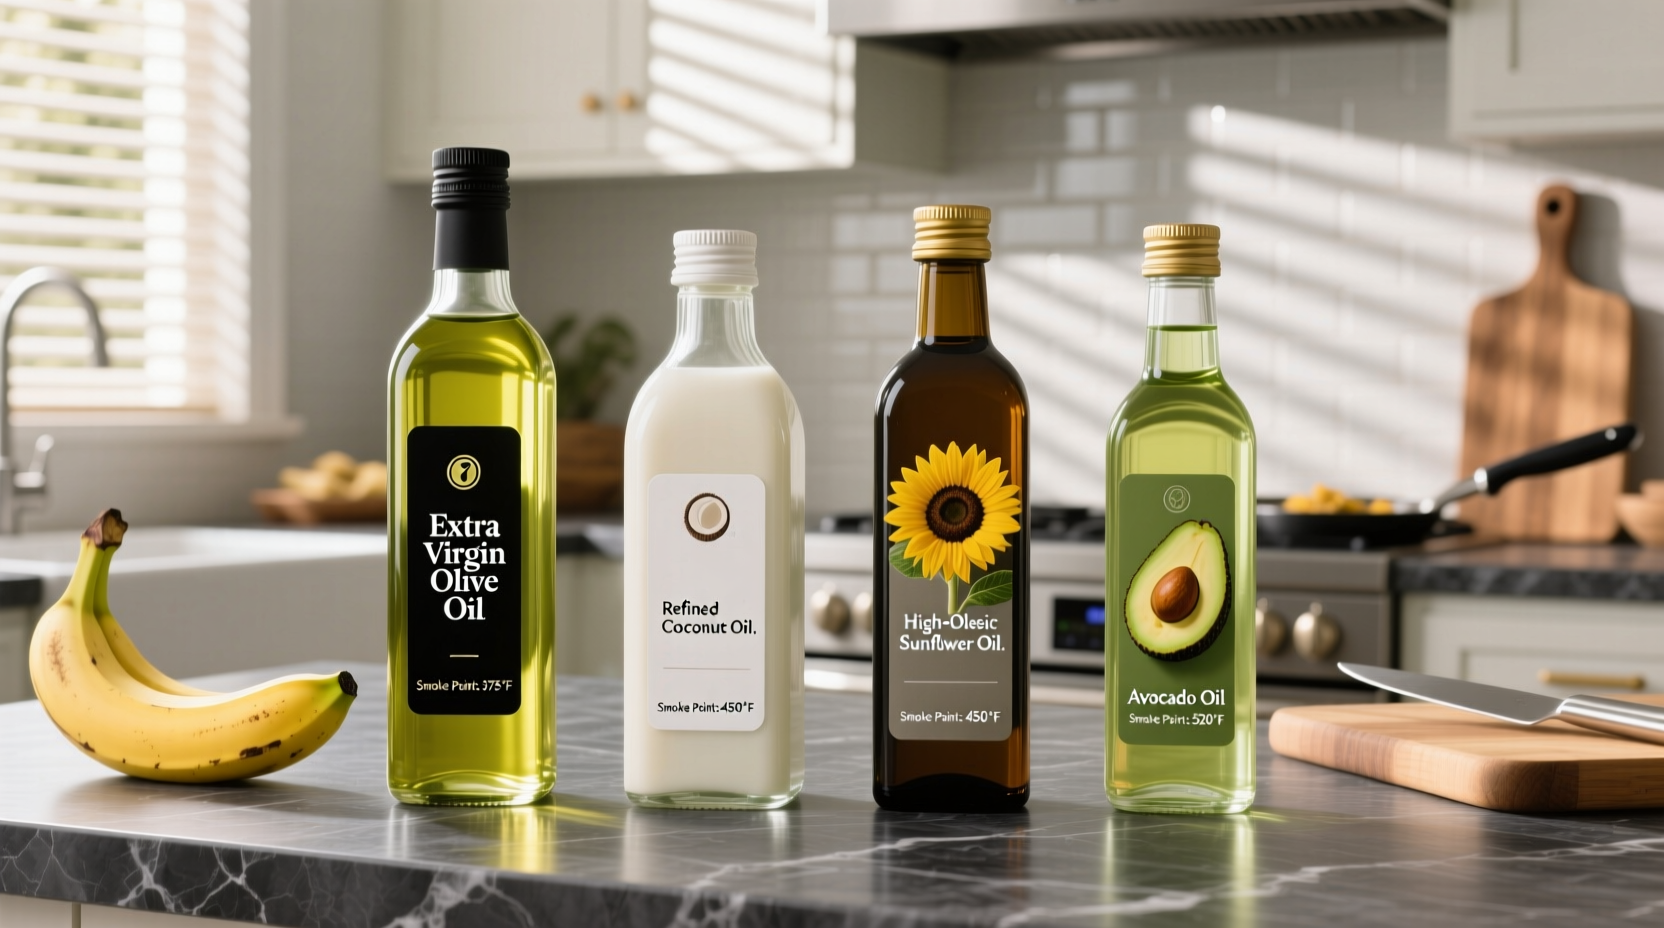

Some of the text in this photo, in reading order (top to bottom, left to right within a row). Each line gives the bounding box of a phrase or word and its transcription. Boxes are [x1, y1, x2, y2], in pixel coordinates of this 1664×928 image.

[429, 513, 501, 538] Extra
[422, 541, 506, 572] Virgin
[430, 568, 499, 593] Olive
[443, 596, 486, 621] Oil
[662, 599, 719, 616] Refined
[661, 619, 757, 635] Coconut Oil.
[899, 633, 1006, 652] Sunflower Oil.
[416, 679, 450, 692] Smoke
[1126, 688, 1226, 706] Avocado Oil
[657, 701, 691, 713] Smoke
[900, 710, 933, 722] Smoke
